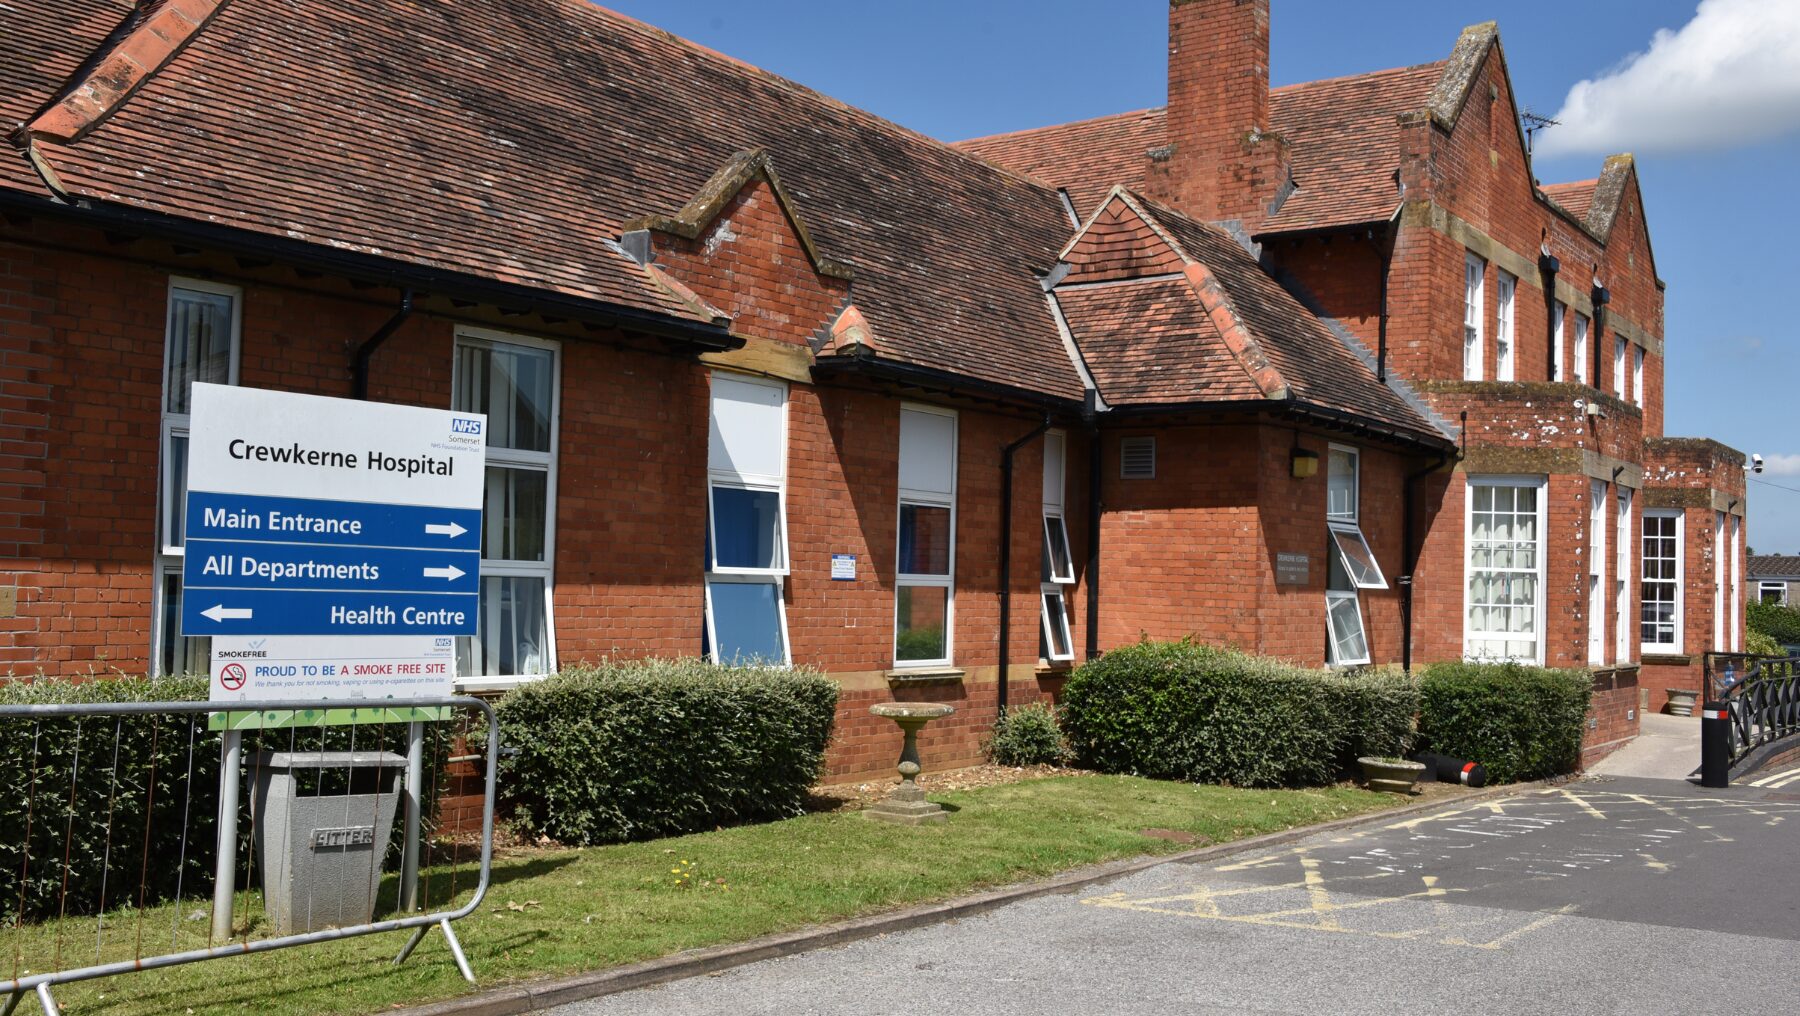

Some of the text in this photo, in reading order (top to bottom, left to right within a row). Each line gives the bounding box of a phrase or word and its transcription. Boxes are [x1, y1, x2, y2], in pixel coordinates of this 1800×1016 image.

[453, 419, 480, 434] NHS
[448, 435, 480, 446] Somerset
[229, 439, 453, 478] Crewkerne Hospital
[204, 508, 362, 535] Main Entrance
[202, 555, 379, 582] All Departments
[331, 605, 465, 625] Health Centre
[255, 663, 446, 677] PROUD TO BE A SMOKE FREE SITE
[343, 679, 361, 687] vaping
[316, 830, 373, 845] LITTER
